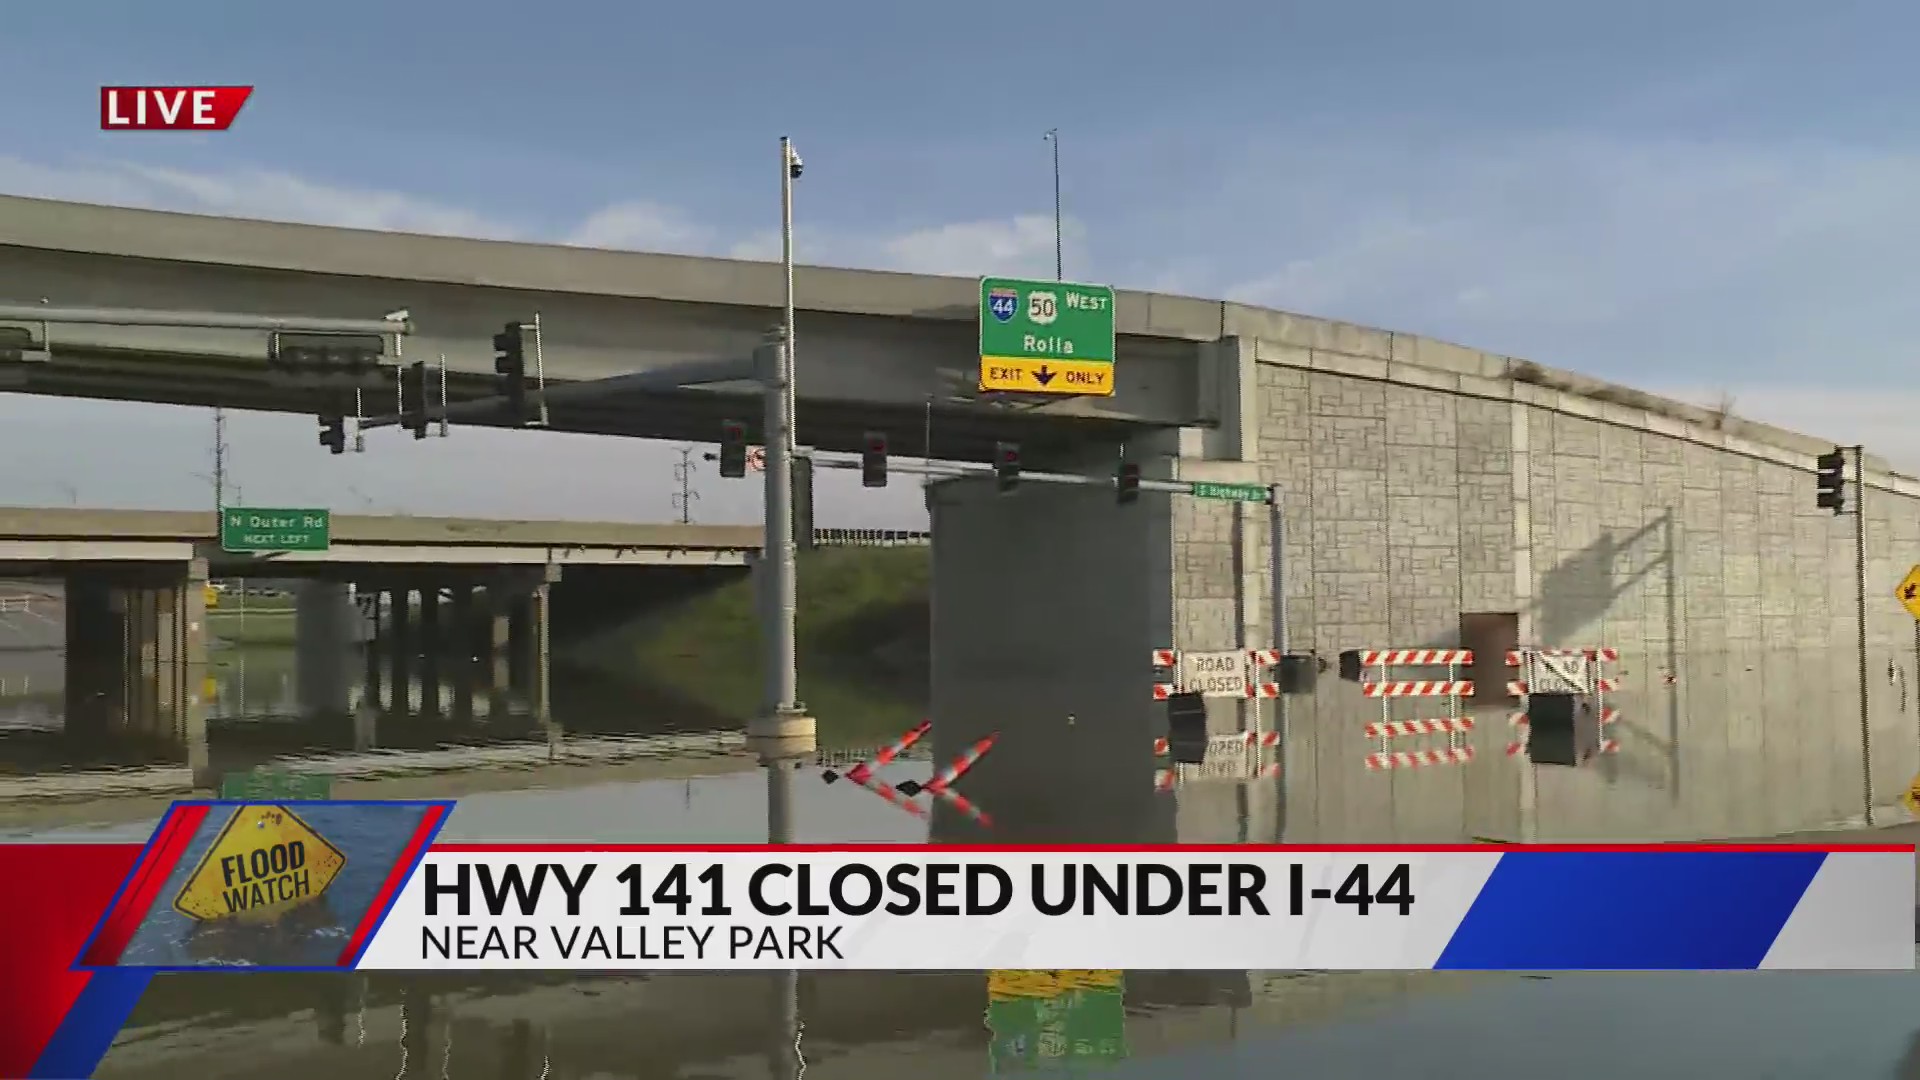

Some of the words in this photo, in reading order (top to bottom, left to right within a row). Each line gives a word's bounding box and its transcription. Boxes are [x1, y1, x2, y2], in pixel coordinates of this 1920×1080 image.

[993, 299, 1014, 315] 44
[1031, 298, 1054, 317] 50
[1065, 291, 1107, 310] WEST
[1023, 334, 1074, 354] Rolla
[990, 366, 1023, 381] EXIT
[1065, 370, 1104, 385] ONLY
[230, 515, 241, 527] N
[249, 516, 296, 529] Outer
[303, 516, 323, 528] Rd
[243, 534, 274, 544] NEXT
[280, 534, 310, 544] LEFT
[1196, 656, 1235, 671] ROAD
[1189, 676, 1243, 693] CLOSED
